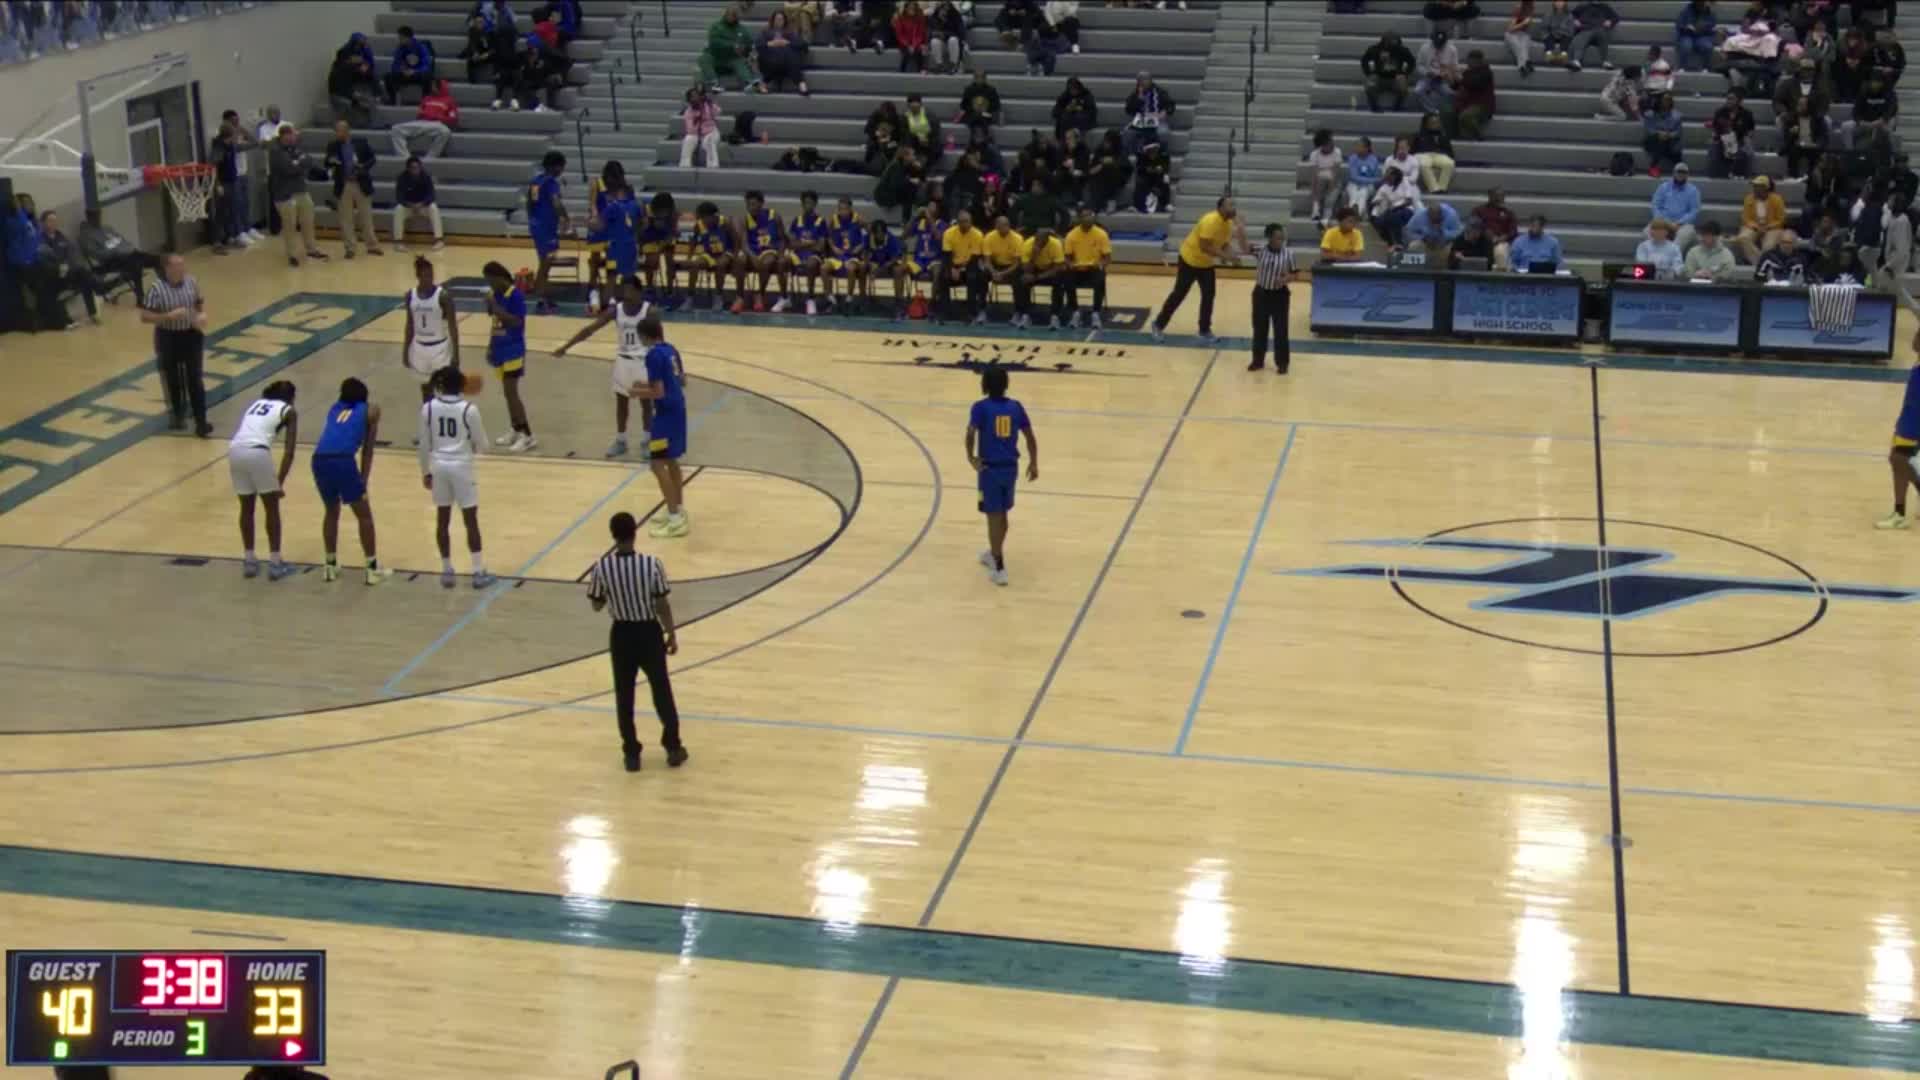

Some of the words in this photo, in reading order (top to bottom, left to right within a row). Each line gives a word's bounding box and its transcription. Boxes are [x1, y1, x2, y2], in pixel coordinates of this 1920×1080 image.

[1473, 319, 1503, 329] HIGH
[1505, 320, 1554, 331] SCHOOL
[624, 332, 636, 345] 11
[248, 403, 271, 416] 15
[336, 409, 353, 423] 11
[438, 417, 457, 438] 10
[995, 415, 1011, 437] 10
